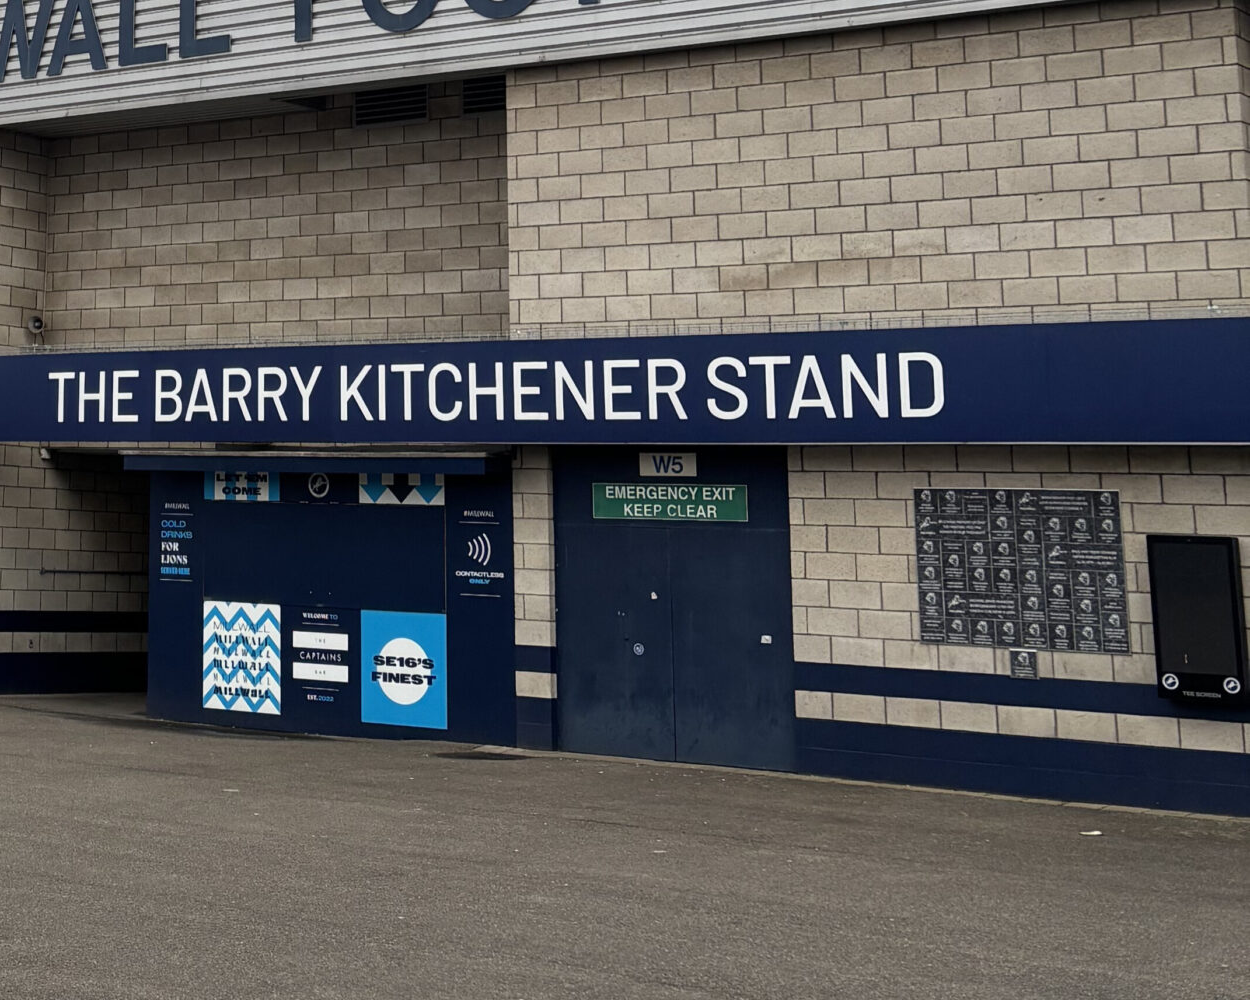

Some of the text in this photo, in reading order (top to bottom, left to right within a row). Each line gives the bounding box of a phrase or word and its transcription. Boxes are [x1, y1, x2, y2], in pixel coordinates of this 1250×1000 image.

[49, 352, 946, 424] THE BARRY KITCHENER STAND
[652, 455, 684, 474] W5
[222, 486, 262, 496] COME
[605, 486, 736, 501] EMERGENCY EXIT
[463, 510, 494, 518] #MILLWALL
[623, 503, 718, 518] KEEP CLEAR
[161, 520, 187, 528] COLD
[161, 530, 193, 539] DRINKS
[161, 541, 179, 552] FOR
[161, 554, 188, 565] LIONS
[455, 570, 505, 578] CONTACTLESS
[302, 612, 329, 620] WELCOME
[213, 621, 271, 633] MILLWALL
[299, 651, 342, 662] CAPTAINS
[373, 655, 435, 669] SE16'S
[371, 671, 437, 686] FINEST
